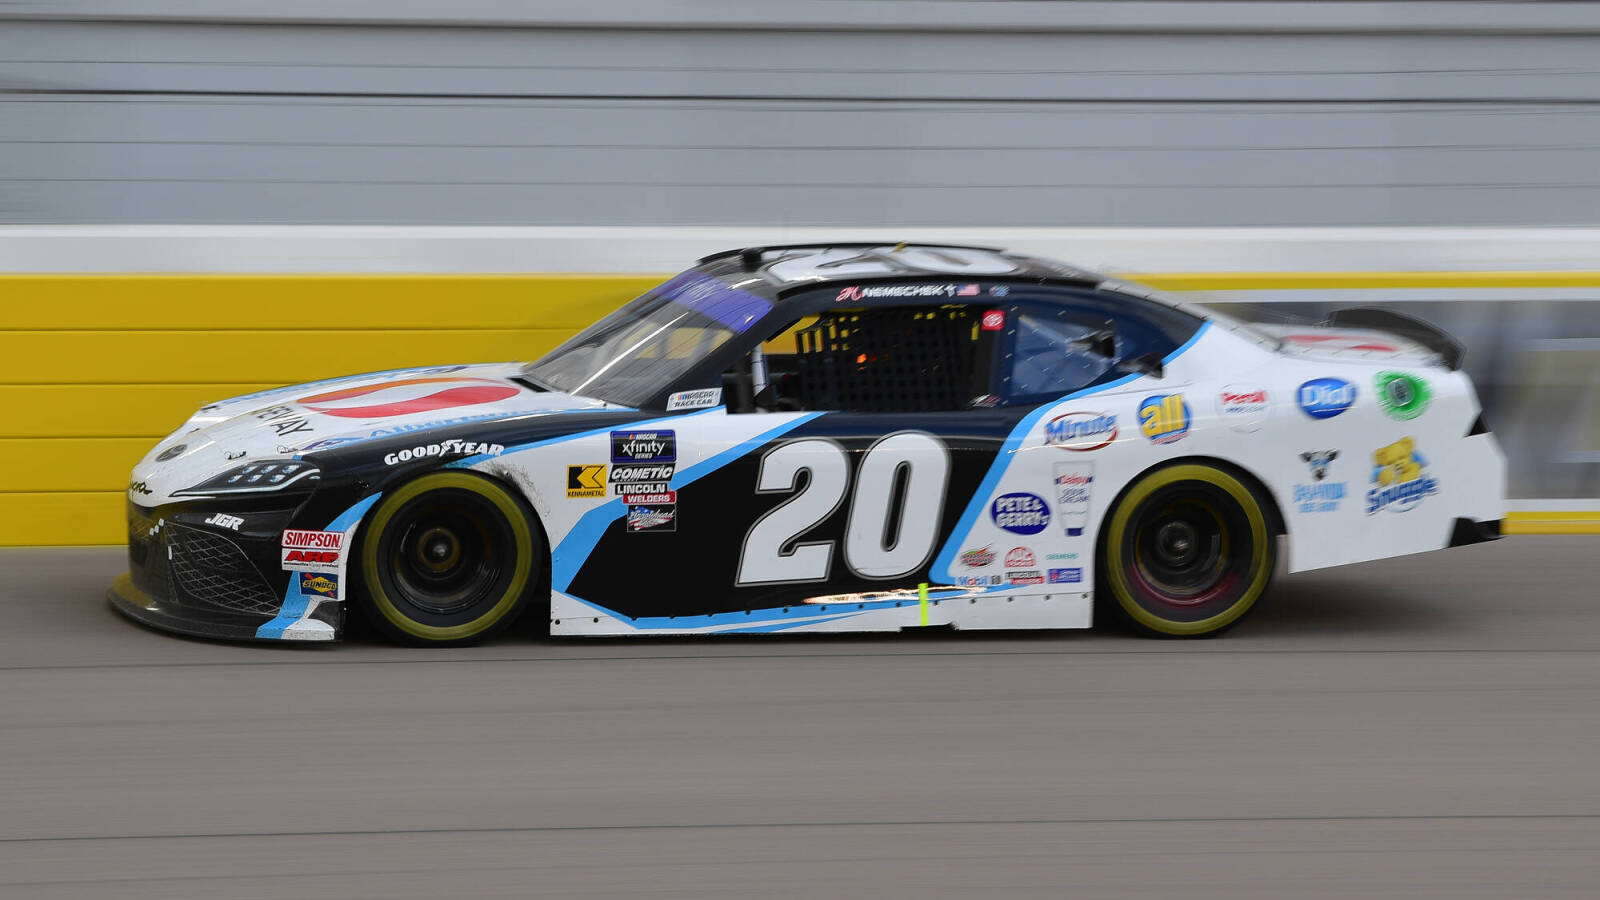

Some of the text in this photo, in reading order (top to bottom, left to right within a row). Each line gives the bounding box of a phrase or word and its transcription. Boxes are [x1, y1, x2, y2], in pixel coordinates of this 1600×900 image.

[861, 284, 945, 298] NEMECHEK
[1300, 384, 1355, 407] Dial
[1140, 394, 1184, 437] all
[1044, 414, 1117, 444] Minute
[622, 440, 665, 456] xfinity
[611, 465, 673, 480] COMETIC
[617, 484, 666, 494] LINCOLN
[627, 494, 671, 503] WELDERS
[735, 430, 951, 587] 20
[205, 513, 244, 530] JGR
[284, 531, 341, 549] SIMPSON
[284, 550, 339, 563] ARP
[303, 580, 337, 590] SUNOCO
